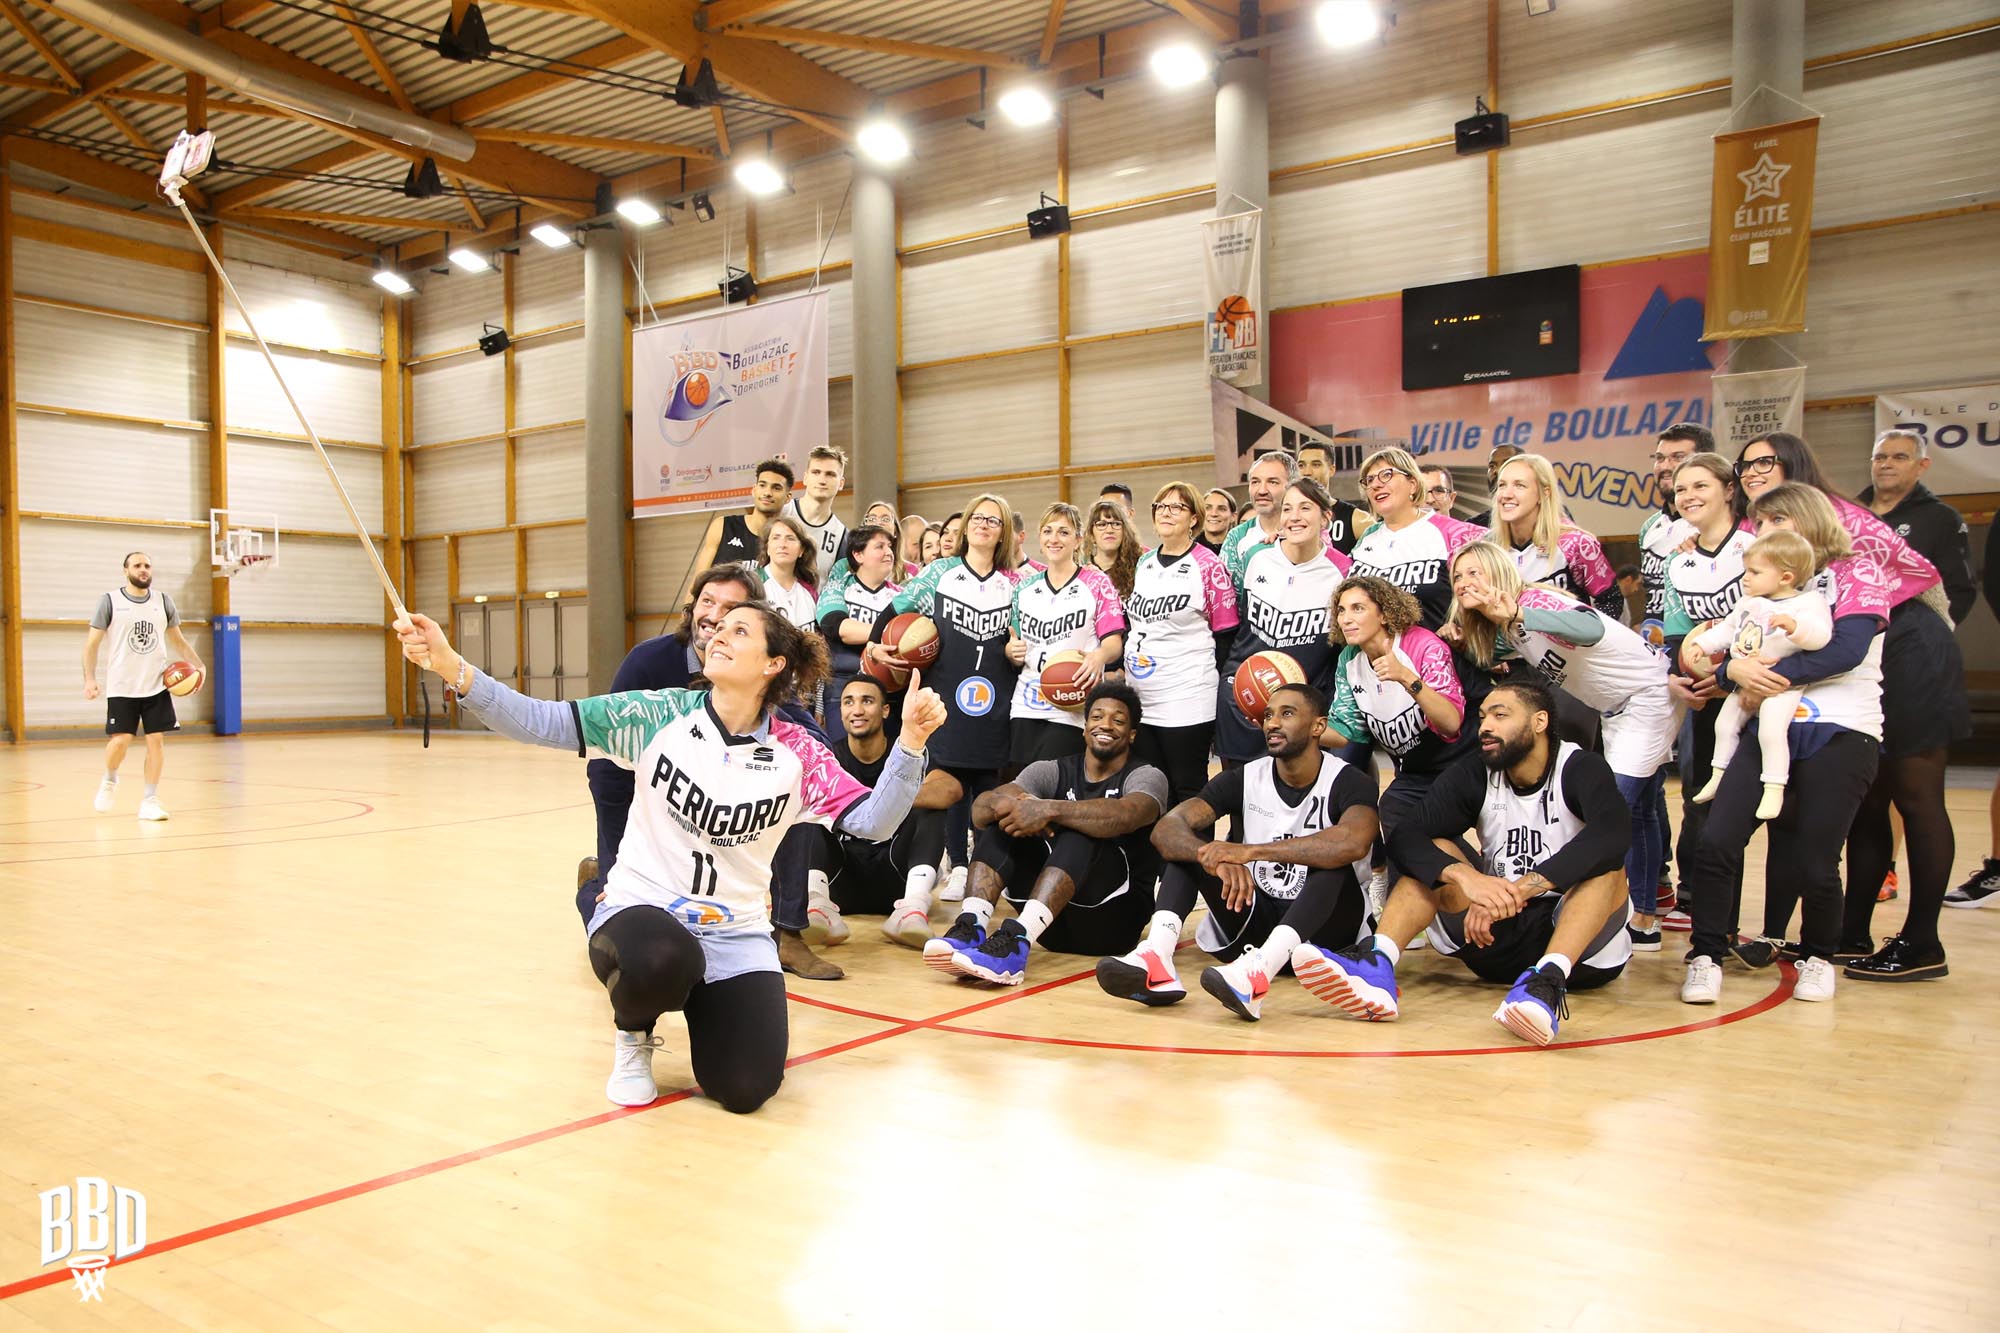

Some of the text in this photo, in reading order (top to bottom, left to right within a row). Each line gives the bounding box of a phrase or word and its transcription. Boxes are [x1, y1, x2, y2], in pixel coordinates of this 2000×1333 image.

[1754, 139, 1778, 149] LABEL
[1734, 203, 1791, 228] ÉLITE
[732, 343, 789, 370] BOULAZAC
[741, 357, 785, 382] BASKET
[1735, 412, 1779, 424] LABEL
[1894, 405, 1967, 417] VILLE
[1410, 420, 1481, 453] Ville
[1493, 416, 1532, 447] de
[821, 530, 836, 554] 15
[134, 620, 154, 635] BBD
[942, 597, 1012, 635] PERIGOR
[1276, 635, 1317, 649] BOULAZAC
[975, 645, 984, 671] 7
[1052, 689, 1086, 701] Jeep
[745, 762, 779, 771] SEAT
[651, 753, 790, 837] PERIGORD
[1303, 795, 1326, 831] 21
[711, 831, 760, 847] BOULAZAC
[1506, 825, 1542, 858] BBD
[691, 850, 718, 897] 11
[1258, 866, 1306, 898] BOULAZAC PERIGORD
